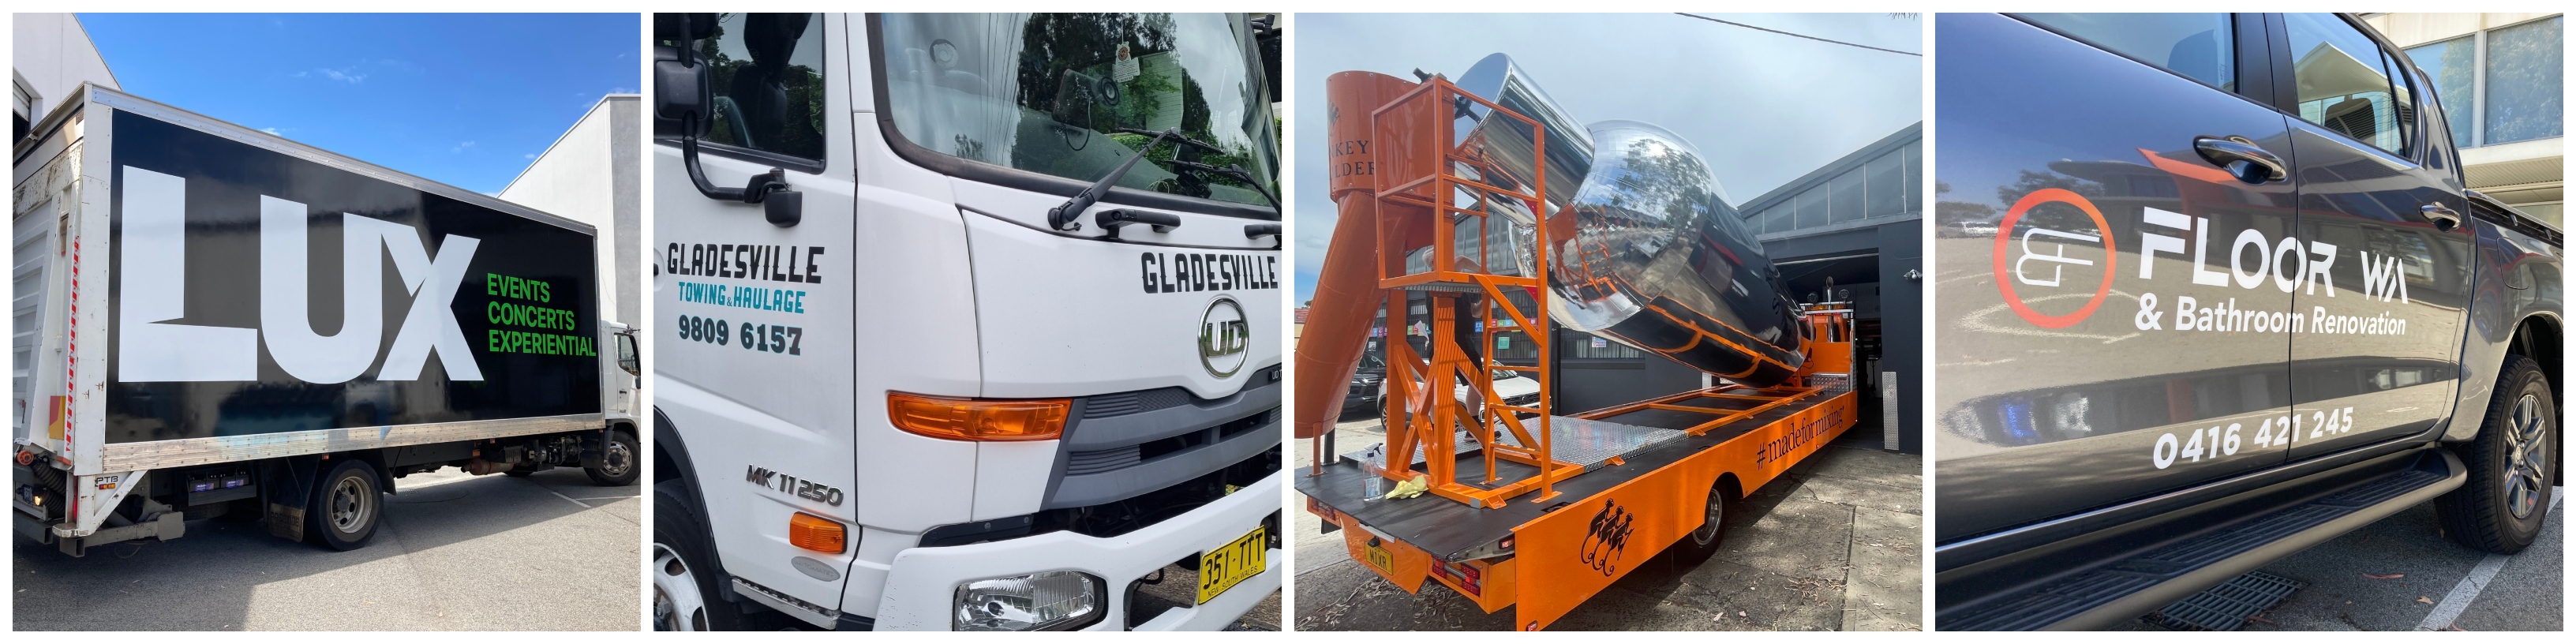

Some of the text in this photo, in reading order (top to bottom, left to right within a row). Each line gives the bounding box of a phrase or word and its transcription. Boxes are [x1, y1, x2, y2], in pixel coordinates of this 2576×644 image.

[118, 165, 485, 384] LUX
[667, 242, 826, 284] GLADESVILLE
[1140, 252, 1279, 294] GLADESVILLE
[2139, 206, 2338, 298] FLOOR
[2360, 250, 2409, 305] WA
[487, 272, 551, 303] EVENTS
[488, 301, 575, 331] CONCERTS
[679, 314, 803, 356] 9809 6157
[2135, 293, 2407, 335] & Bathroom Renovation
[489, 329, 597, 357] EXPERIENTIAL
[1204, 320, 1249, 358] UD
[2153, 406, 2353, 470] 0416 421 245
[746, 463, 777, 490] MK
[1208, 565, 1258, 597] NEW SOUTH WALES
